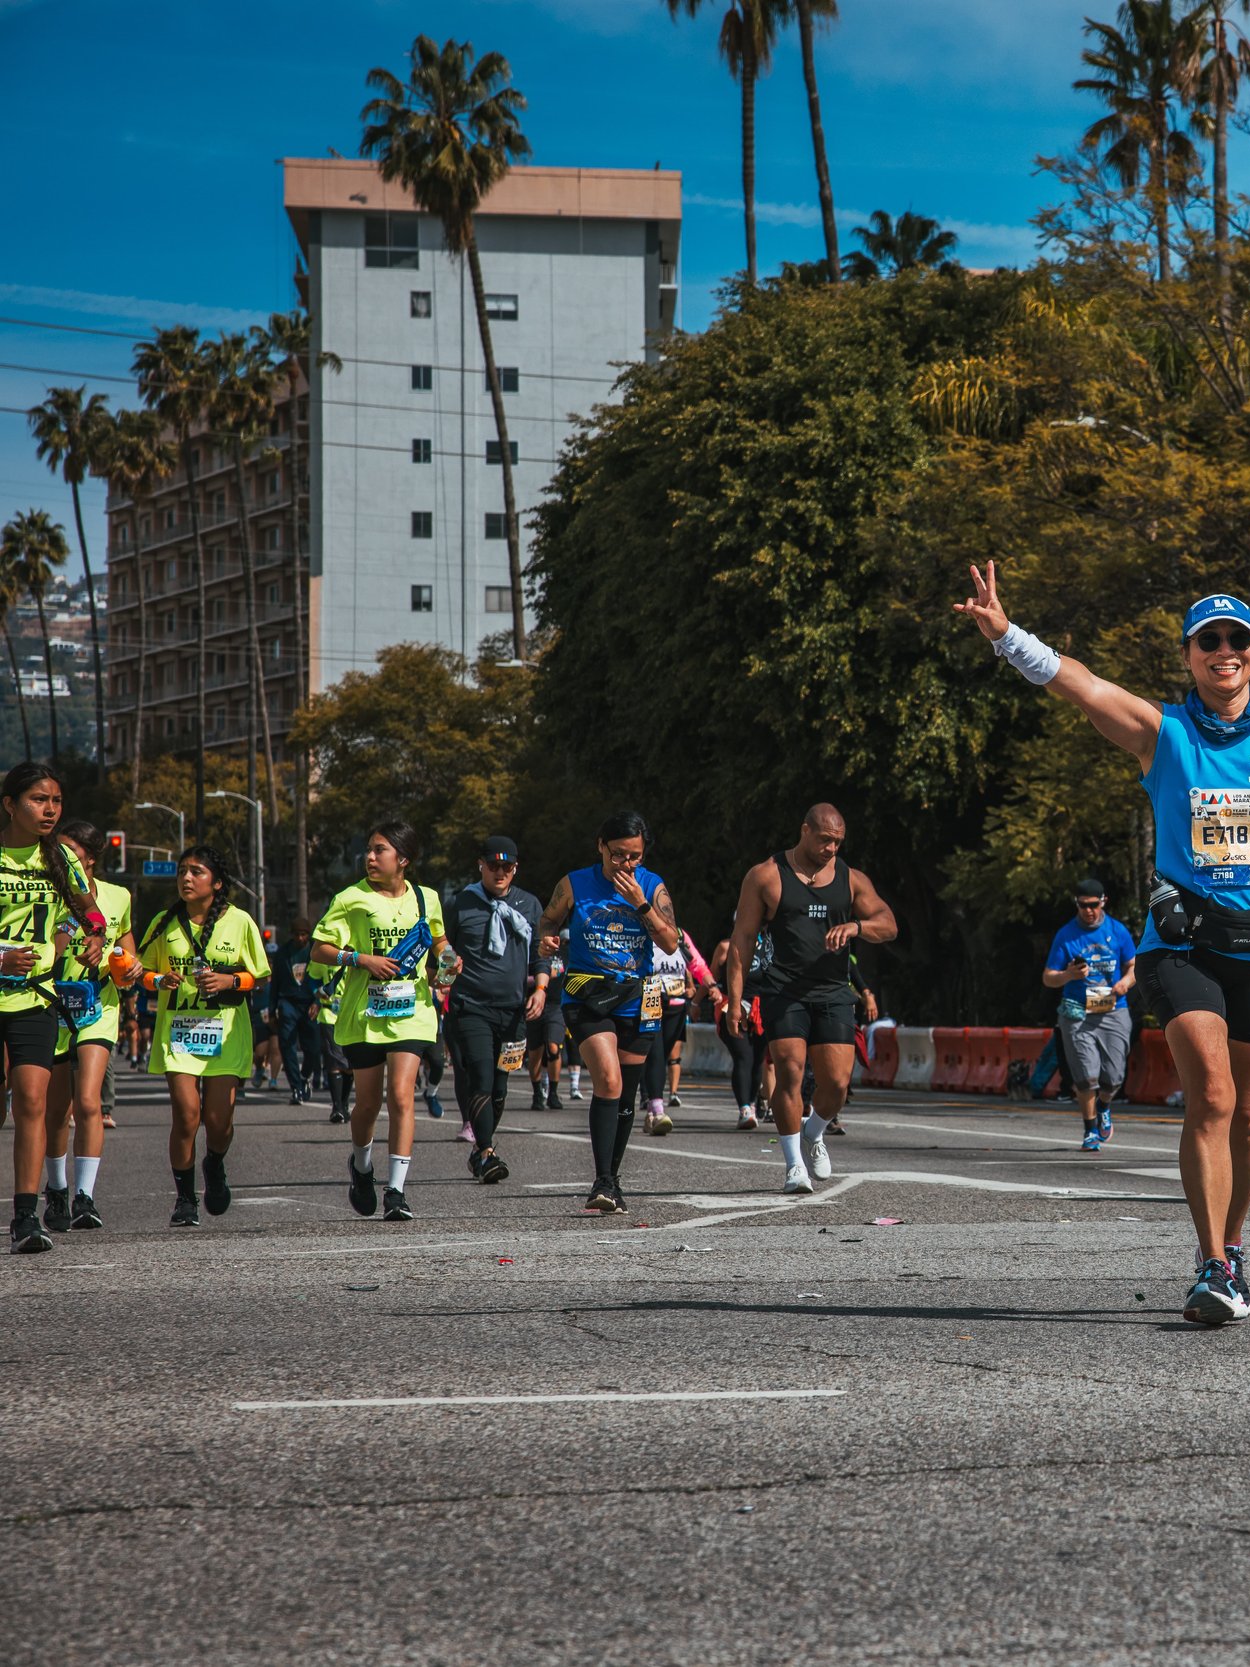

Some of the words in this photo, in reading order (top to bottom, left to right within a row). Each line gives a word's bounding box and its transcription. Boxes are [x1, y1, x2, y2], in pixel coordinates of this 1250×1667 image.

[1212, 871, 1233, 879] E7180
[0, 880, 53, 891] tudent
[0, 891, 58, 904] un
[370, 926, 411, 938] Stude
[607, 922, 624, 933] 40
[583, 932, 601, 940] LOS
[168, 956, 224, 967] Studt
[646, 996, 660, 1008] 239
[175, 1031, 217, 1045] 32080
